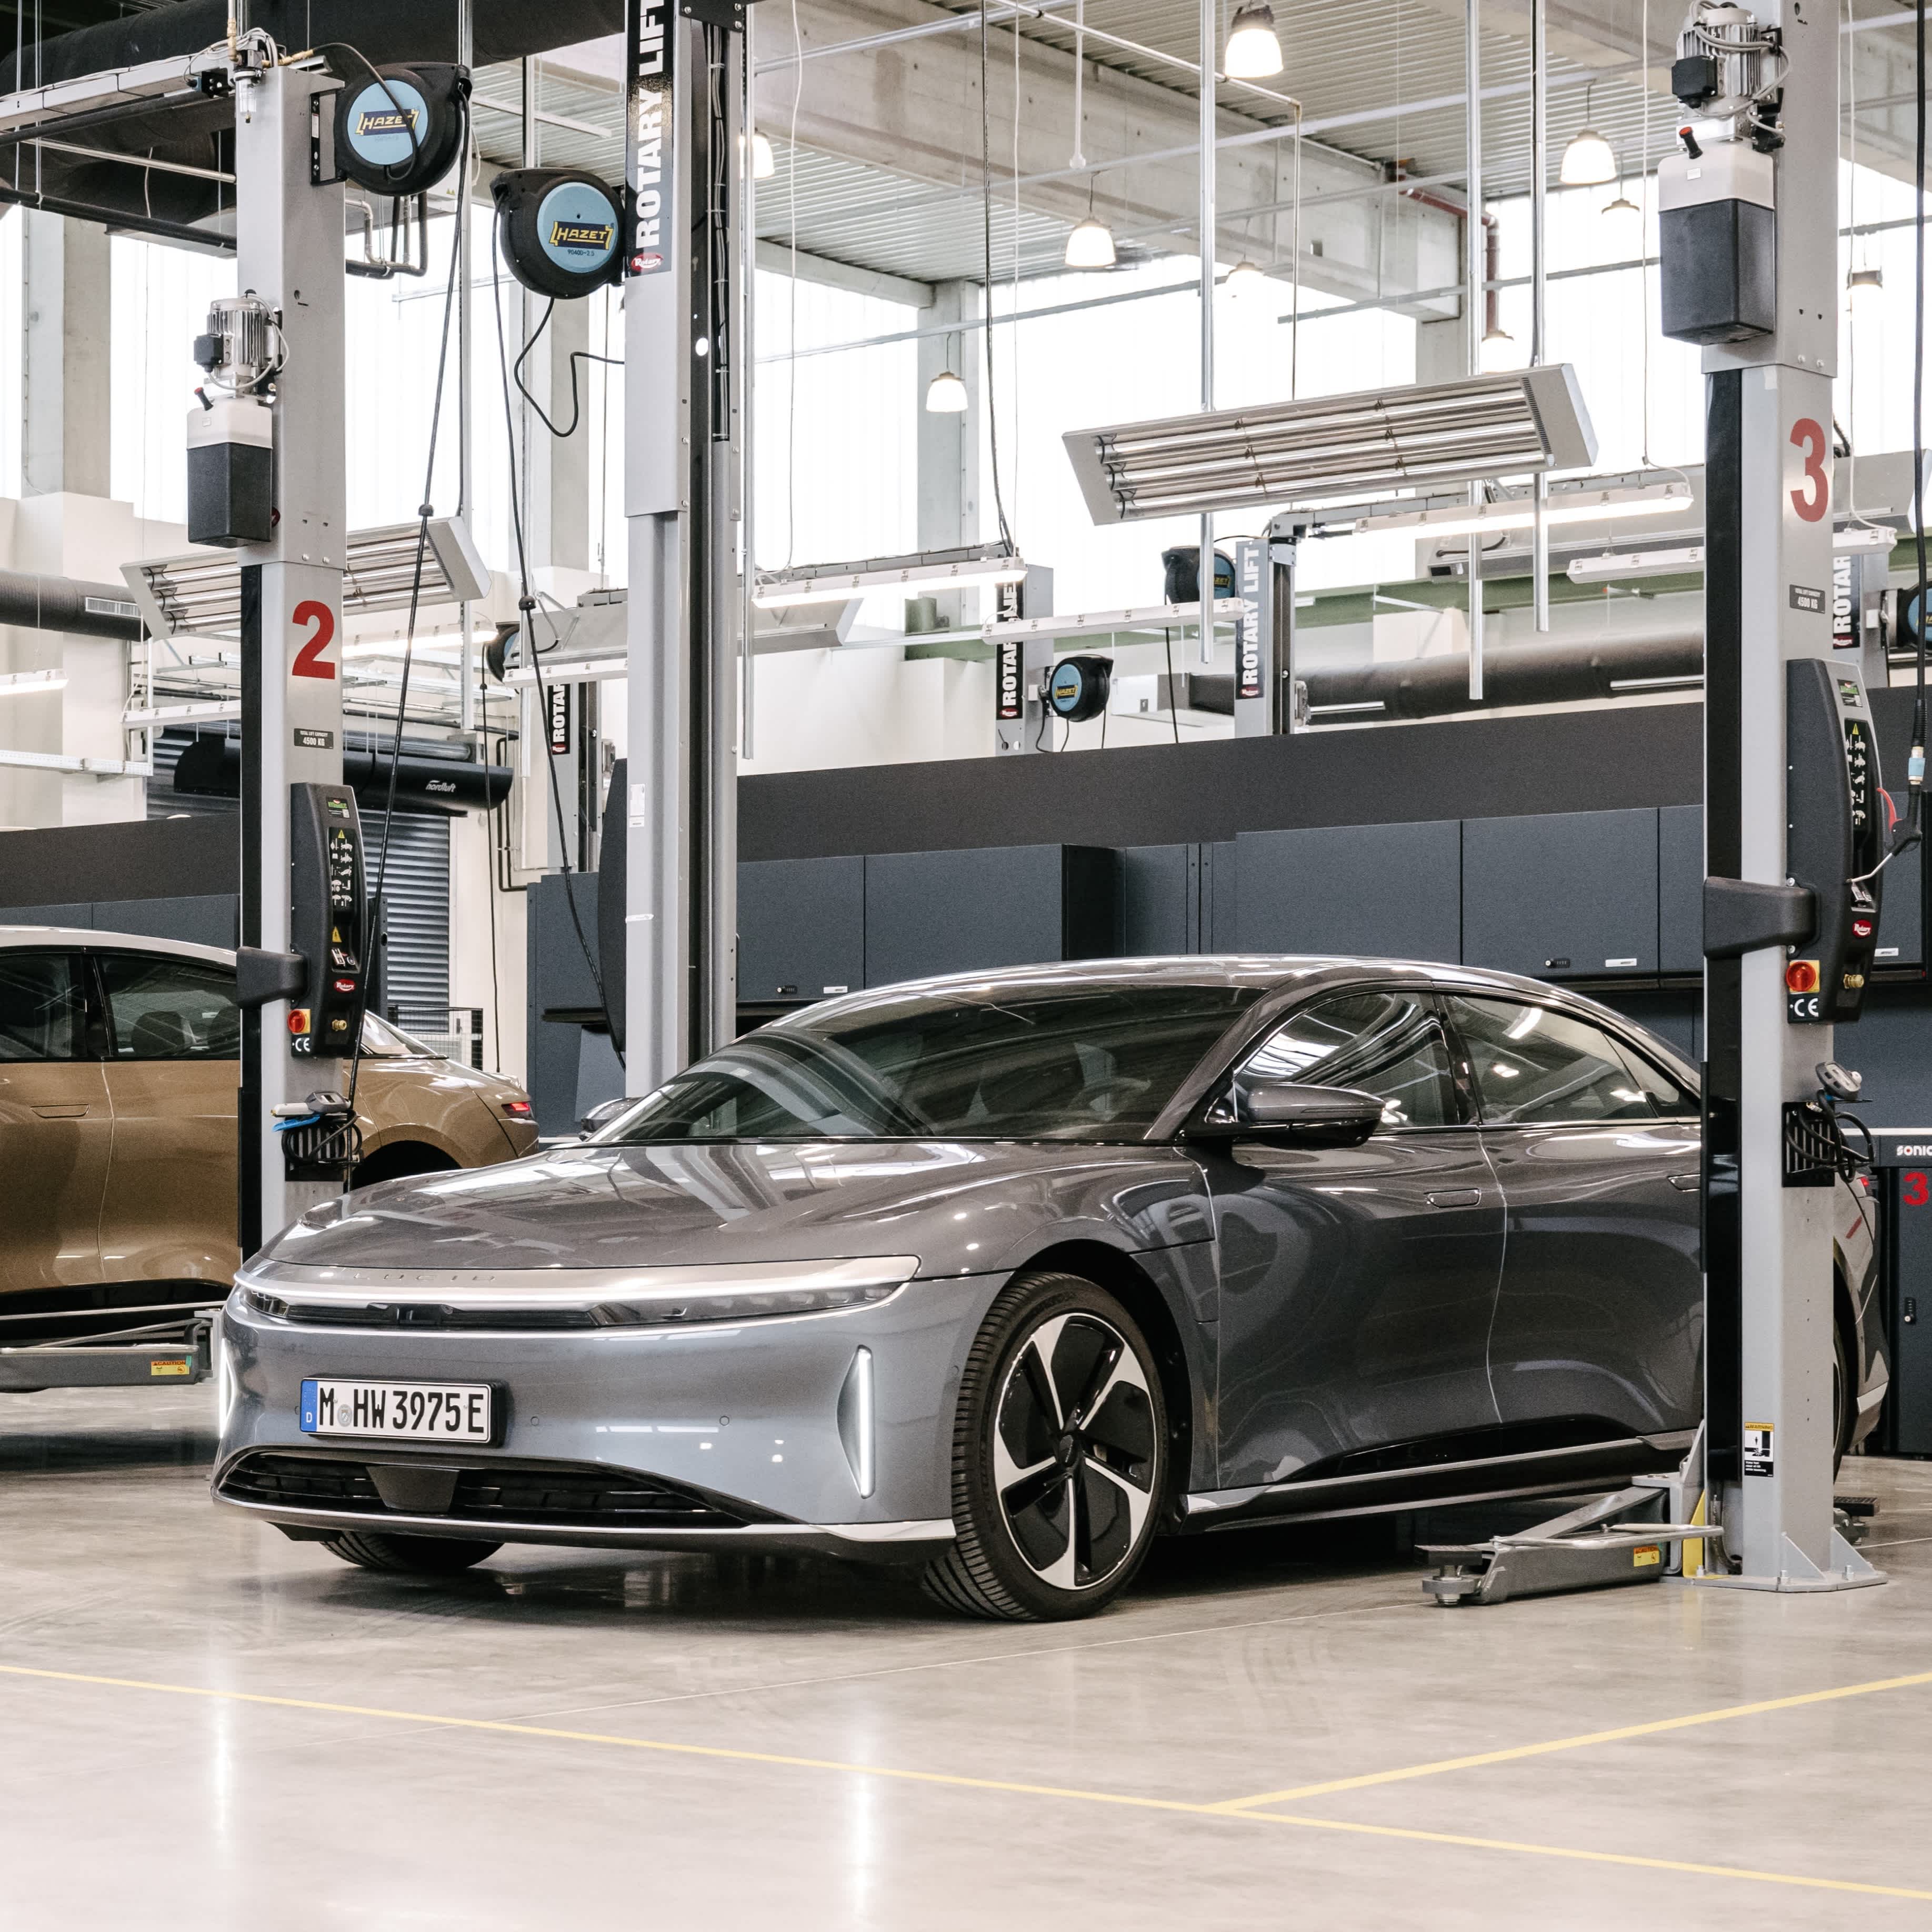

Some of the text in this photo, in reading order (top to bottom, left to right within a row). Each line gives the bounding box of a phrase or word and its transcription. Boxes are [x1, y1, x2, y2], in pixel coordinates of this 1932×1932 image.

[636, 0, 664, 248] ROTARY LIFT
[557, 227, 607, 242] HAZET
[1790, 418, 1828, 522] 3
[1798, 596, 1810, 607] 4500
[1834, 556, 1851, 633] ROTAR
[1243, 547, 1258, 685] ROTARY LIFT
[292, 600, 335, 679] 2
[303, 737, 325, 746] 4500 KG
[1794, 998, 1819, 1017] CE
[295, 1037, 311, 1052] CE
[1903, 1171, 1929, 1206] 3
[353, 1273, 495, 1282] LUCID
[306, 1412, 312, 1423] D
